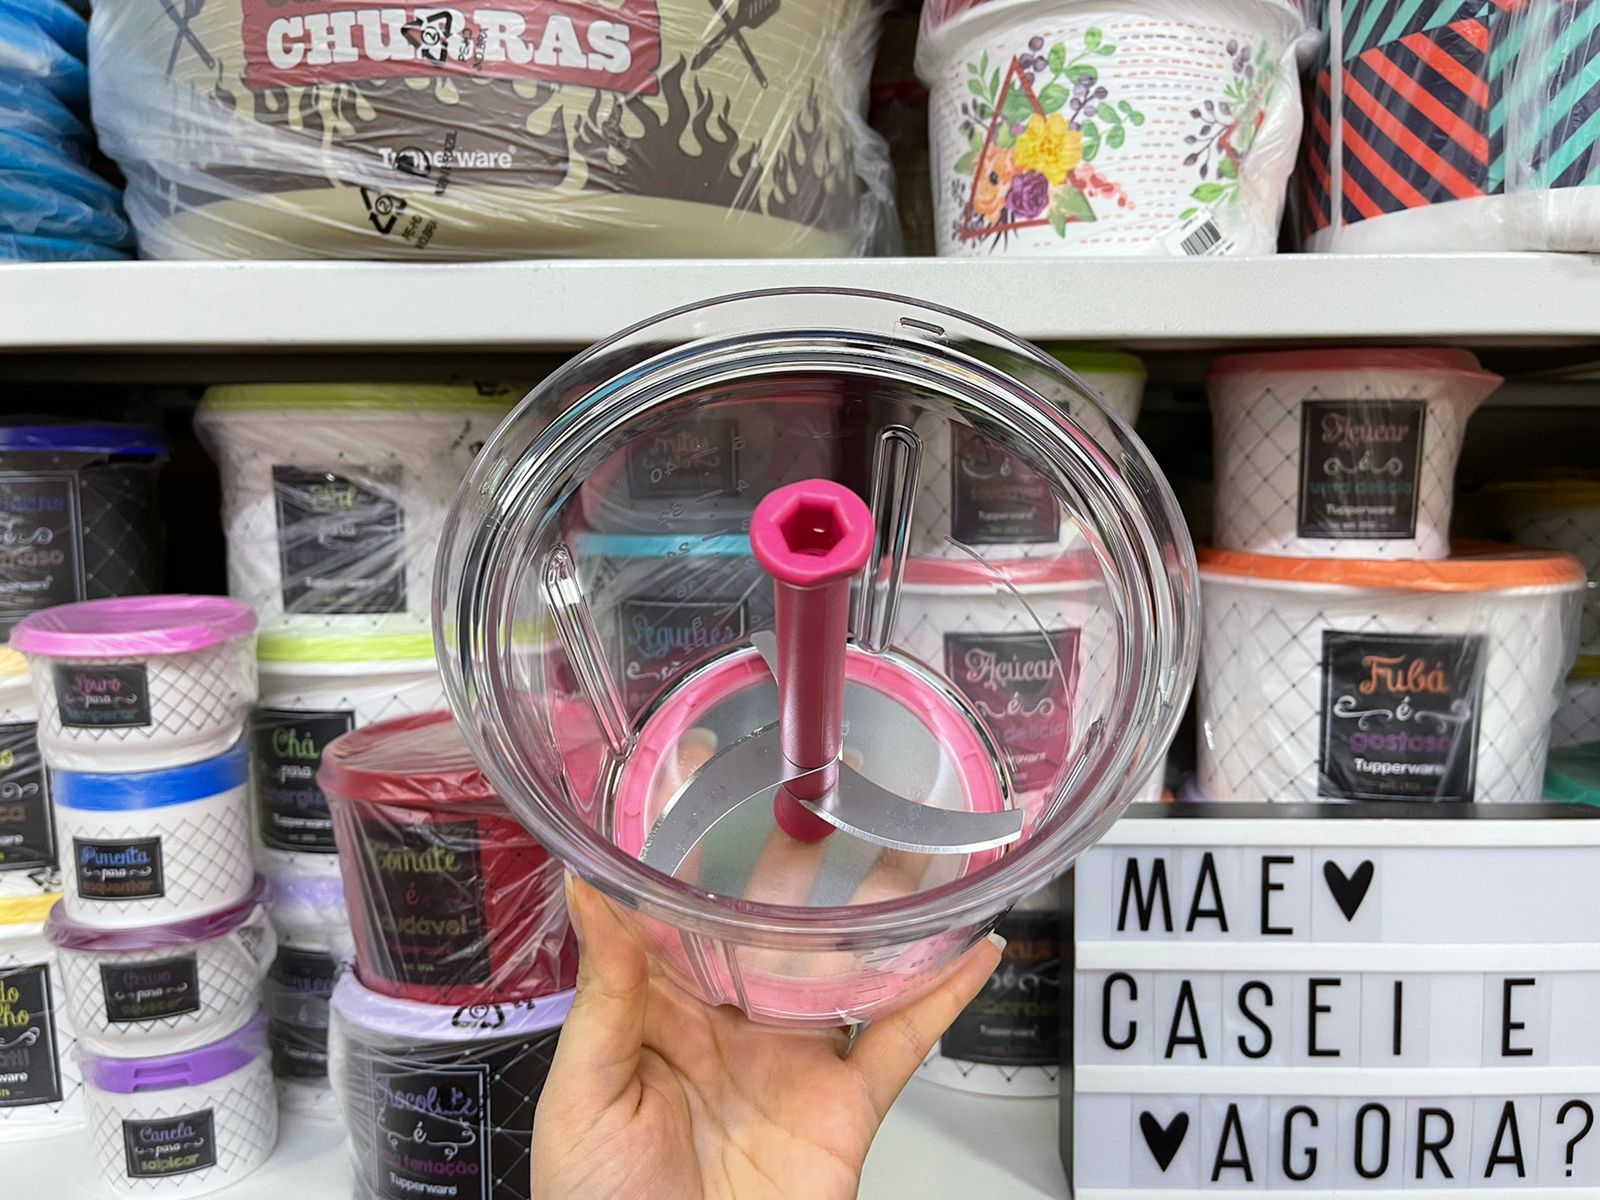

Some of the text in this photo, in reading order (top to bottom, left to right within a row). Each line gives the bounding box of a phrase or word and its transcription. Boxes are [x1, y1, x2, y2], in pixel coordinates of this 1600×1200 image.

[266, 8, 632, 74] CHURRAS
[377, 146, 513, 170] Tperware
[963, 646, 1062, 692] Açúcar
[1359, 654, 1451, 695] Fubá
[272, 726, 320, 760] Chá
[1353, 757, 1446, 777] Tupperware
[80, 845, 152, 867] Pimenta
[1117, 852, 1295, 935] MAE
[1102, 971, 1537, 1059] CASEI E
[139, 1120, 197, 1143] Canela
[1211, 1099, 1595, 1183] AGORA?
[154, 1142, 182, 1159] para
[389, 1170, 458, 1196] Tupperware
